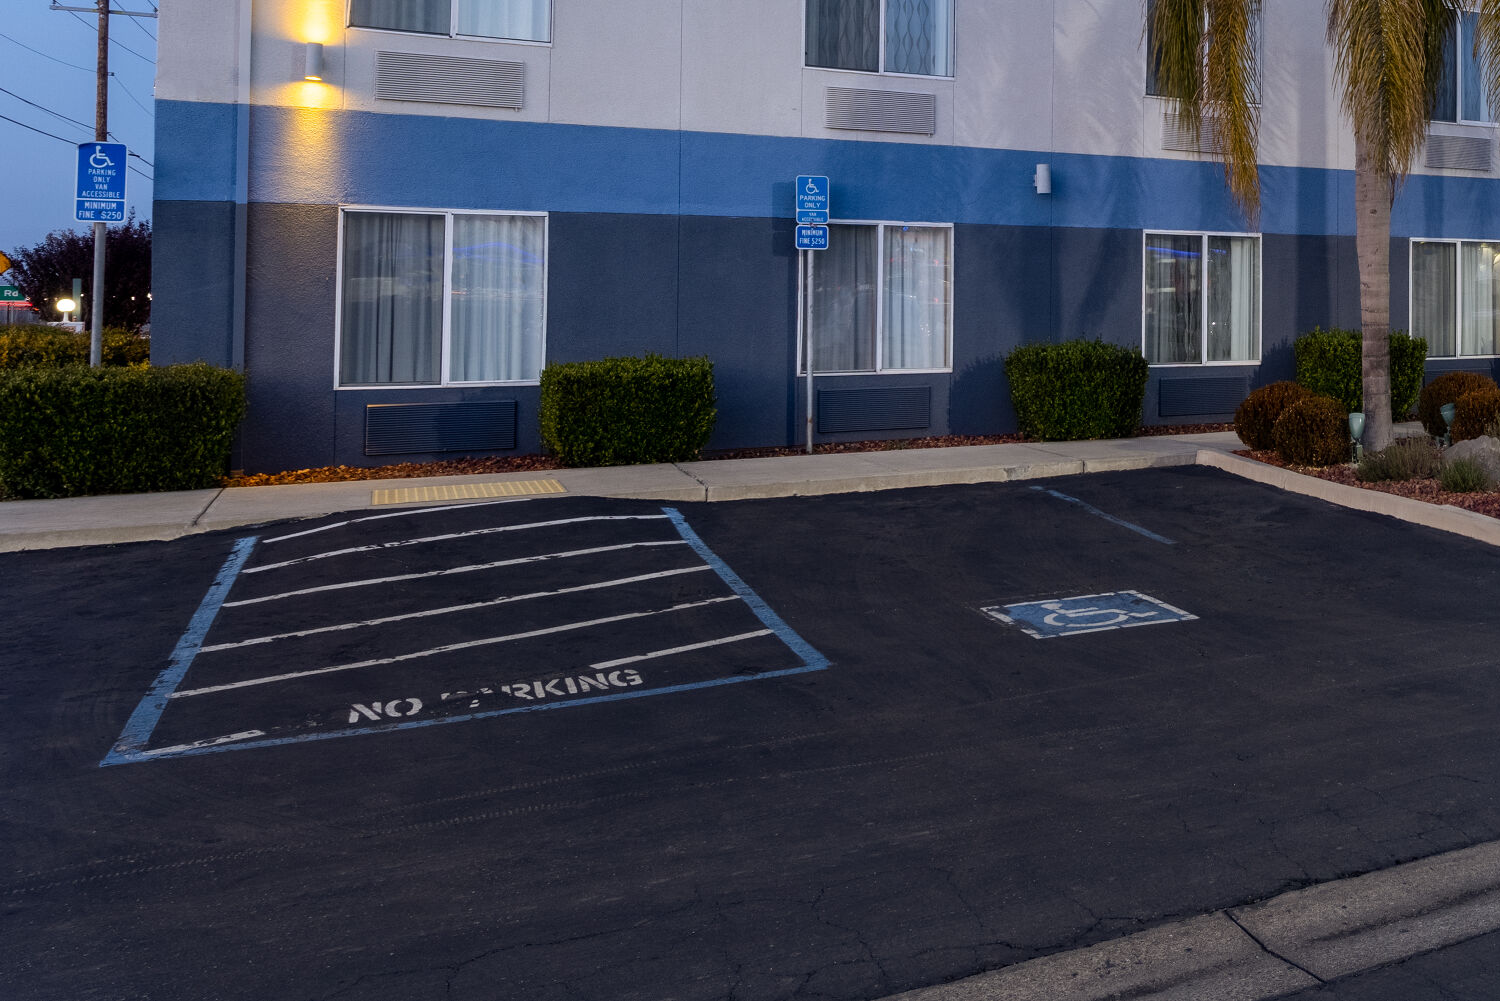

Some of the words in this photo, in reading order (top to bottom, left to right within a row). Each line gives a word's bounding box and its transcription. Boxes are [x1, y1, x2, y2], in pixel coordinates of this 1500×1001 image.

[88, 168, 116, 176] PARKING
[81, 190, 120, 198] ACCESSIBLE
[800, 194, 826, 202] PARKING
[84, 201, 117, 210] MINIMUM
[78, 210, 95, 219] FINE
[100, 211, 122, 220] $250
[799, 237, 810, 245] FINE
[811, 237, 825, 245] $250
[3, 289, 19, 297] Rd
[348, 697, 423, 724] NO
